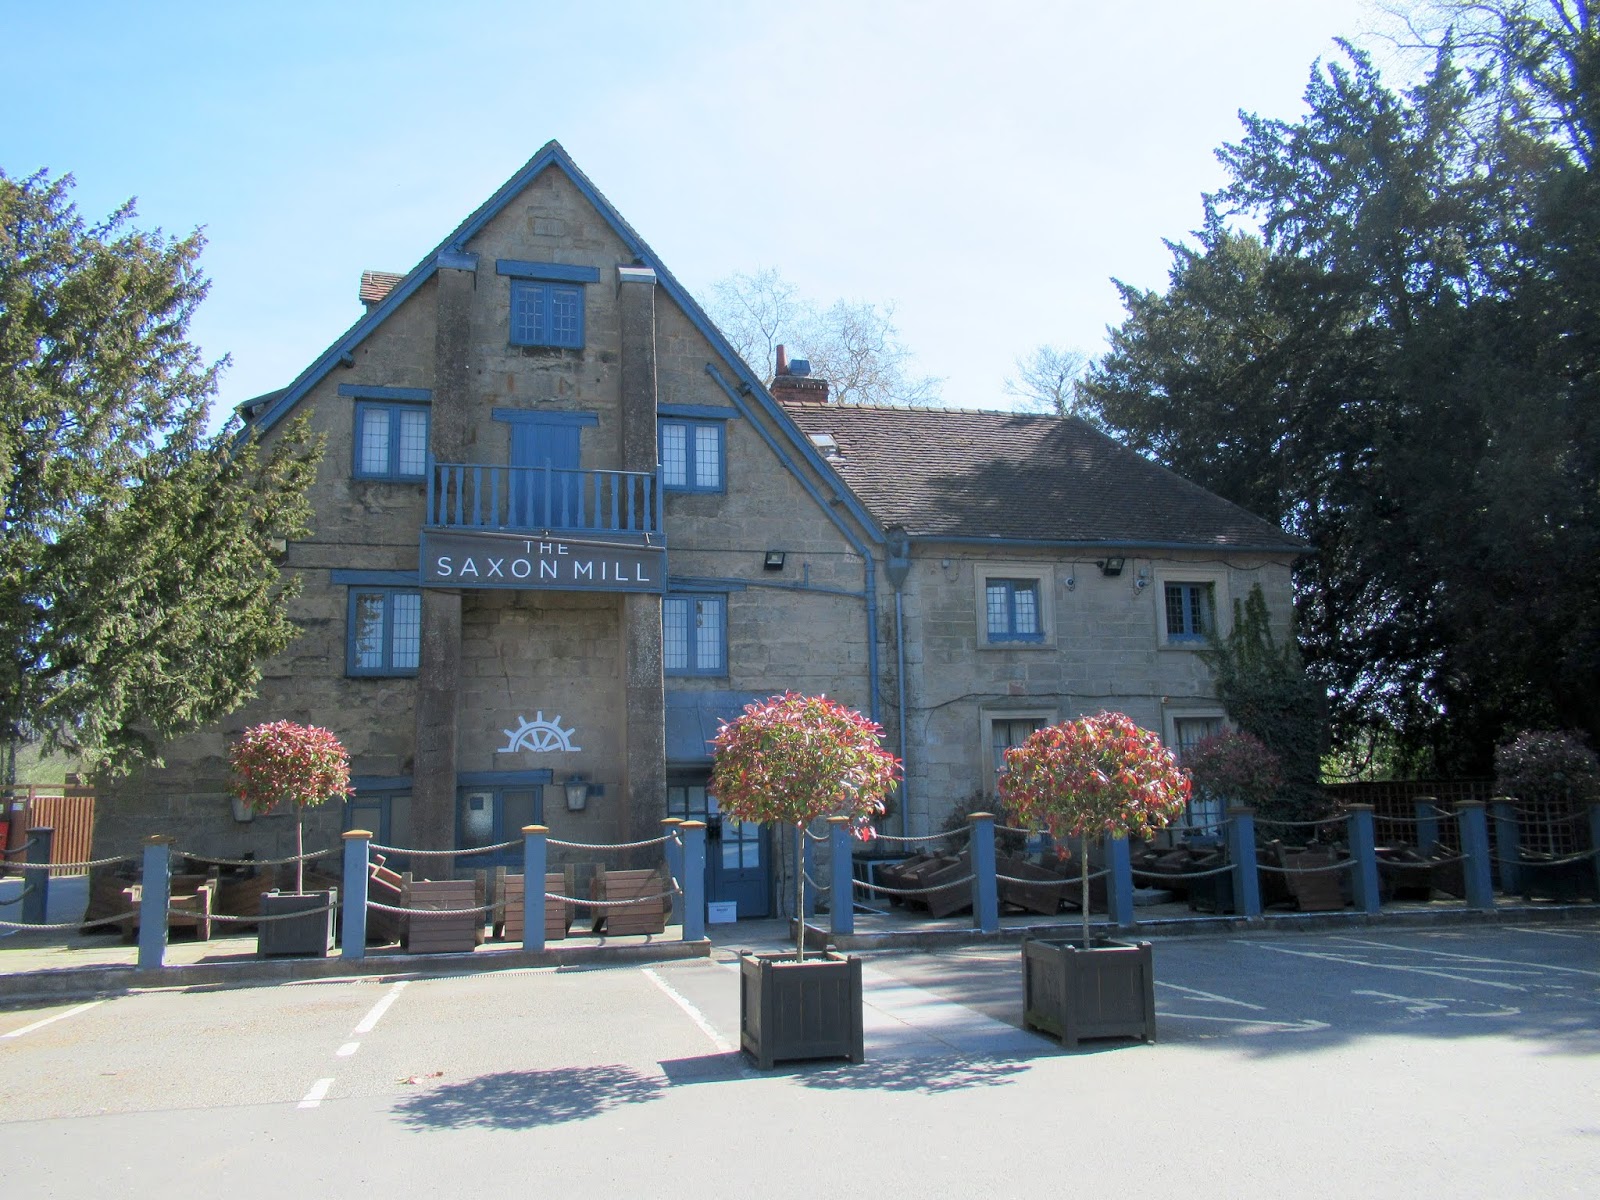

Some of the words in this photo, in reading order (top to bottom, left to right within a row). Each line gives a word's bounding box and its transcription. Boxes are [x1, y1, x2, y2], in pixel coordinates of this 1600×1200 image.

[523, 540, 569, 555] THE
[436, 556, 558, 580] SAXON
[574, 561, 650, 582] MILL
